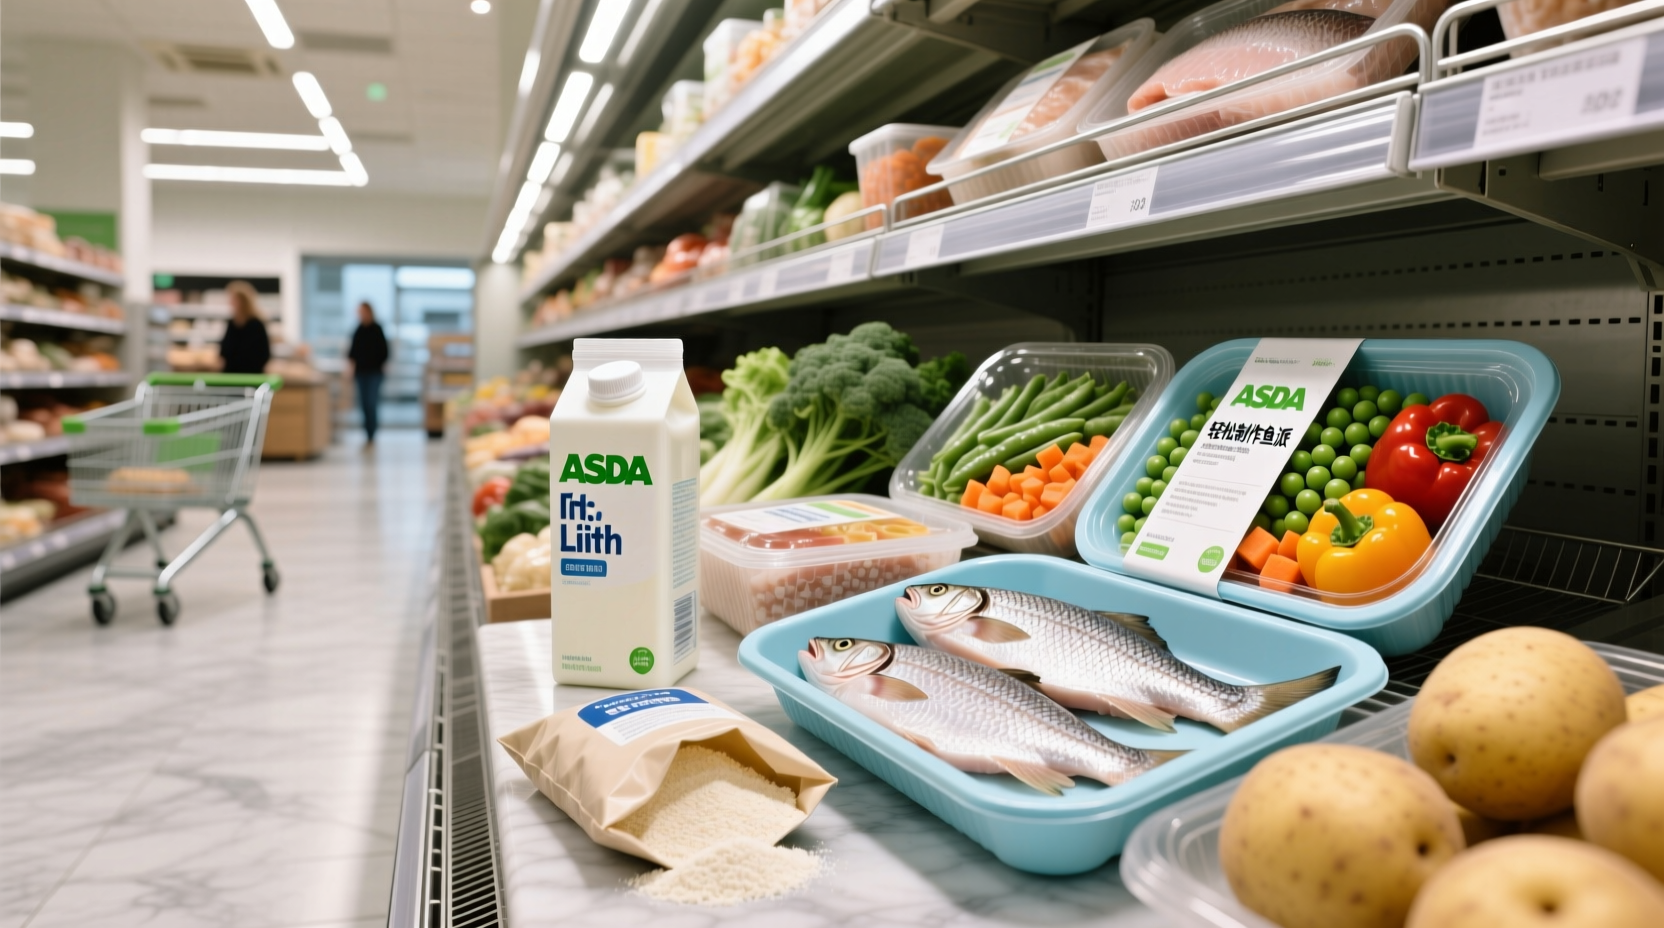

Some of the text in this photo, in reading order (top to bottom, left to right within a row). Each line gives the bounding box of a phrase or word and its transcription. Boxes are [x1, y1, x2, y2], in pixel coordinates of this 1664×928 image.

[1230, 384, 1306, 411] ASDA
[559, 453, 653, 486] ASDA
[560, 523, 622, 556] Liith
